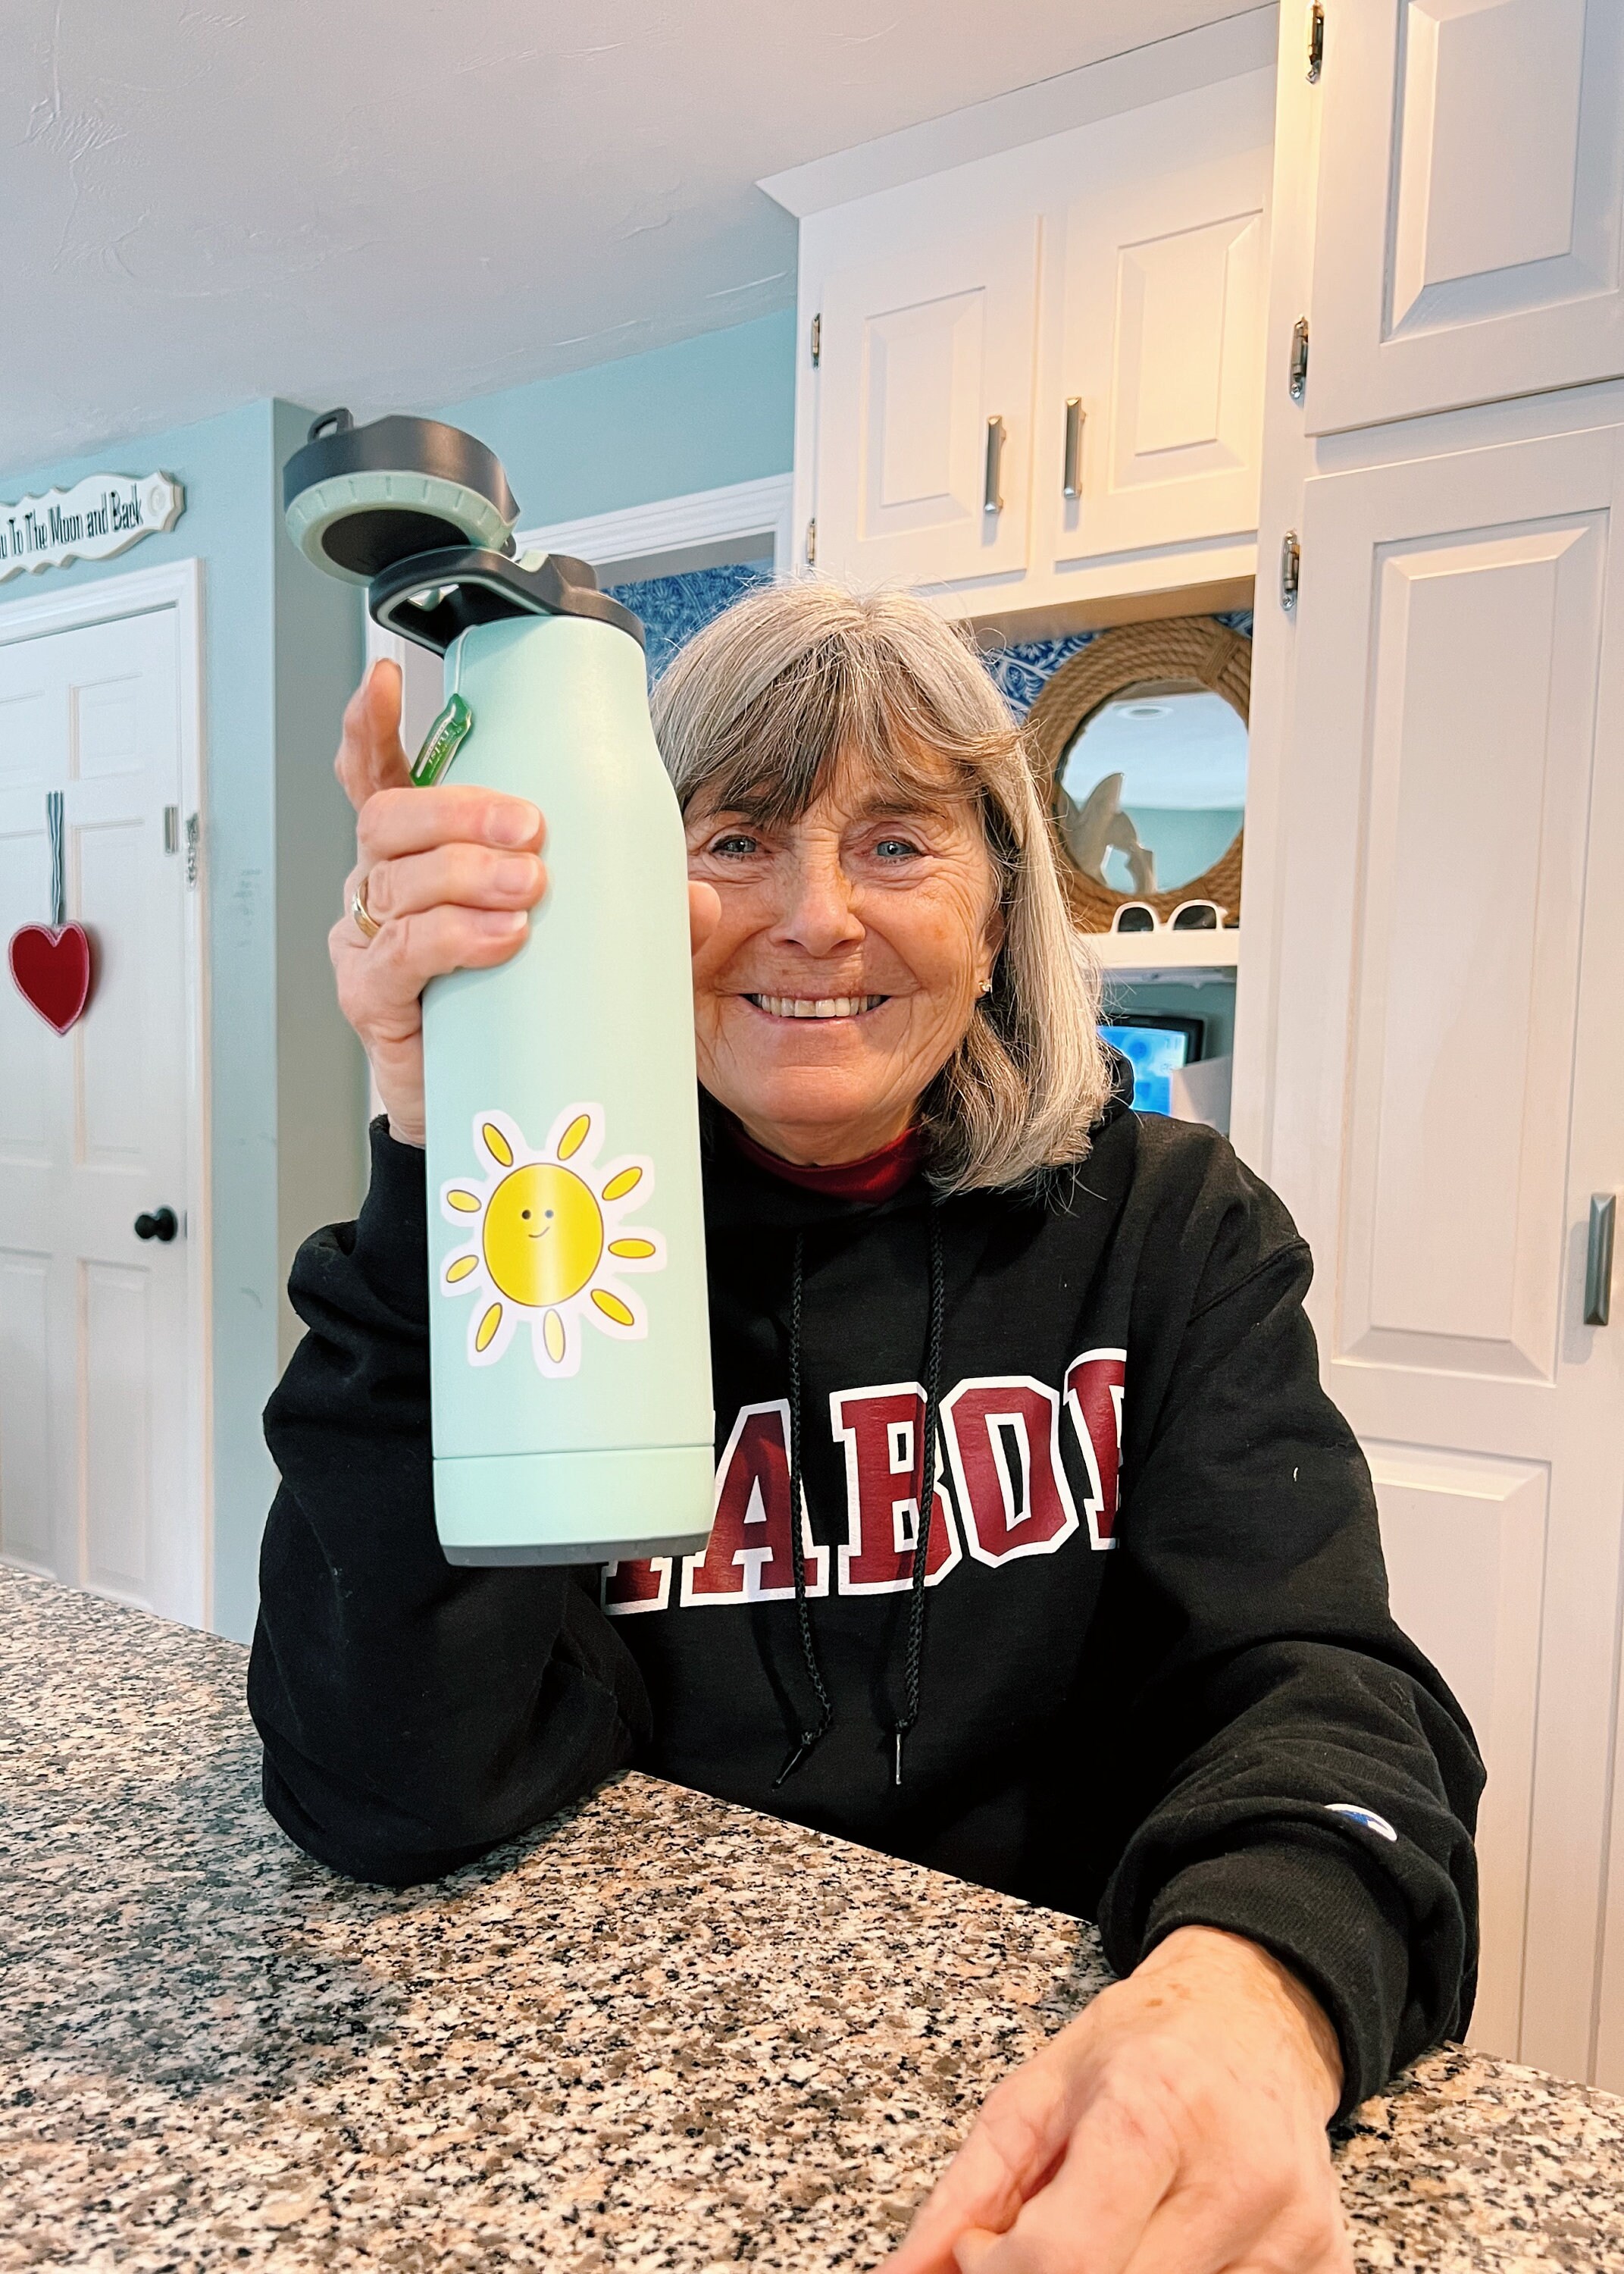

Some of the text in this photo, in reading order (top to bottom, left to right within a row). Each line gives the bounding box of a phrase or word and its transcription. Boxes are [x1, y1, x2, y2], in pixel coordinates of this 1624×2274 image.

[7, 517, 23, 557] To
[25, 509, 48, 553] The
[48, 504, 83, 547] Moon
[86, 491, 108, 539] and
[109, 483, 144, 532] Back
[601, 1348, 1127, 1616] ABO
